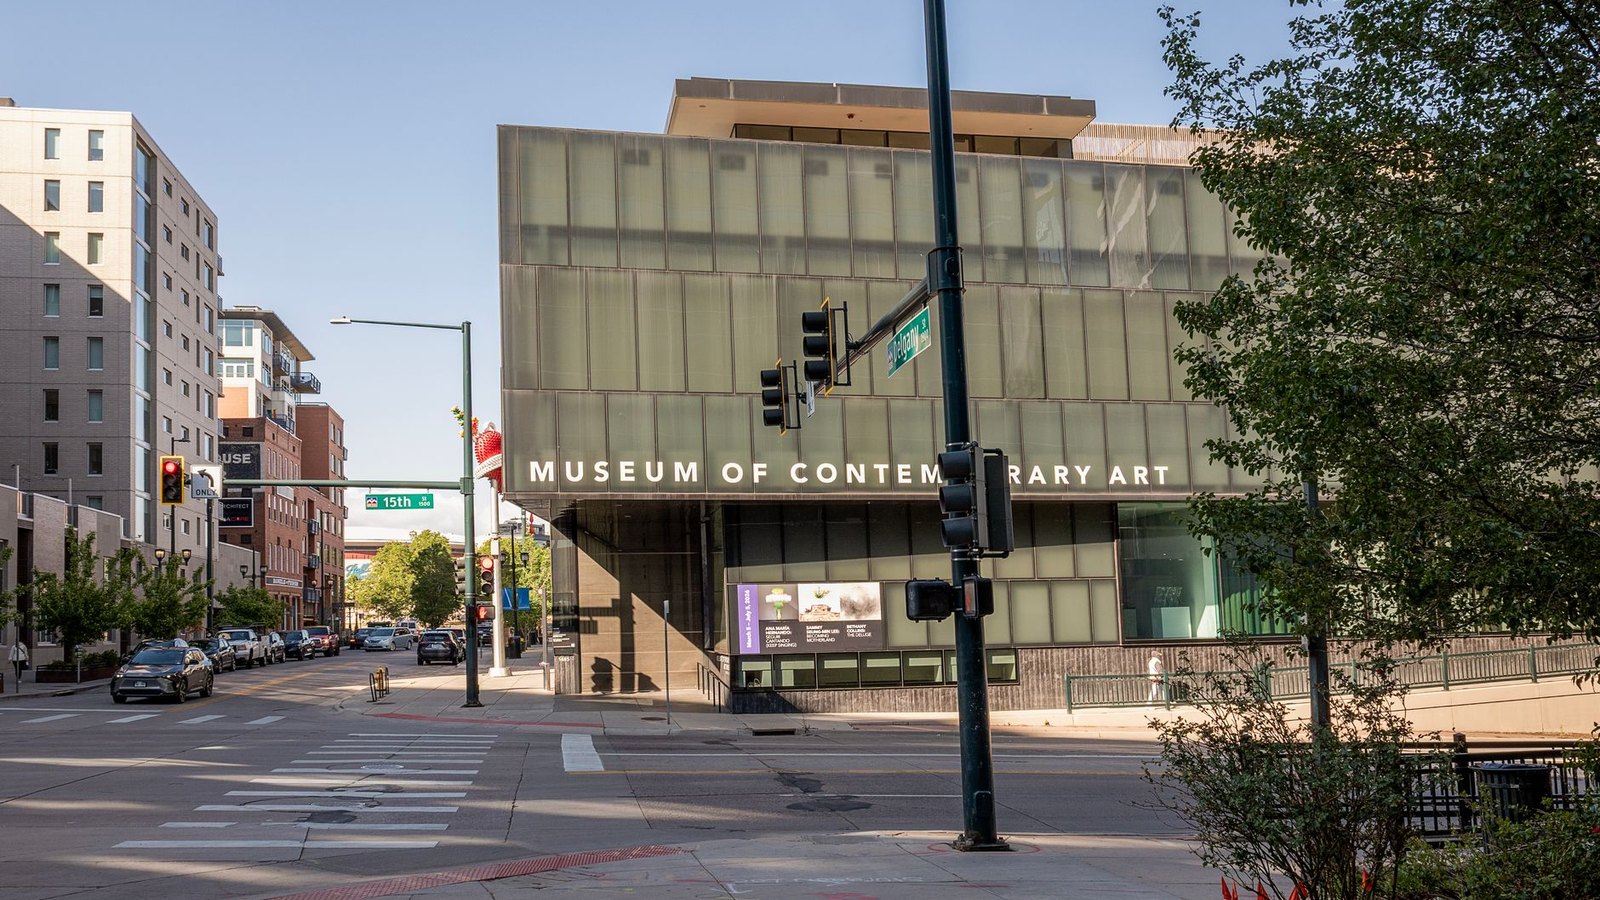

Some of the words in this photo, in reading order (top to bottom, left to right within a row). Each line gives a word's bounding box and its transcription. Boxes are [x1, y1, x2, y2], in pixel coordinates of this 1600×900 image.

[893, 325, 919, 362] Delgany
[529, 461, 698, 482] MUSEUM
[721, 462, 767, 483] OF
[790, 463, 1091, 485] CONTEMRARY
[1108, 465, 1169, 485] ART
[383, 495, 411, 507] 15th
